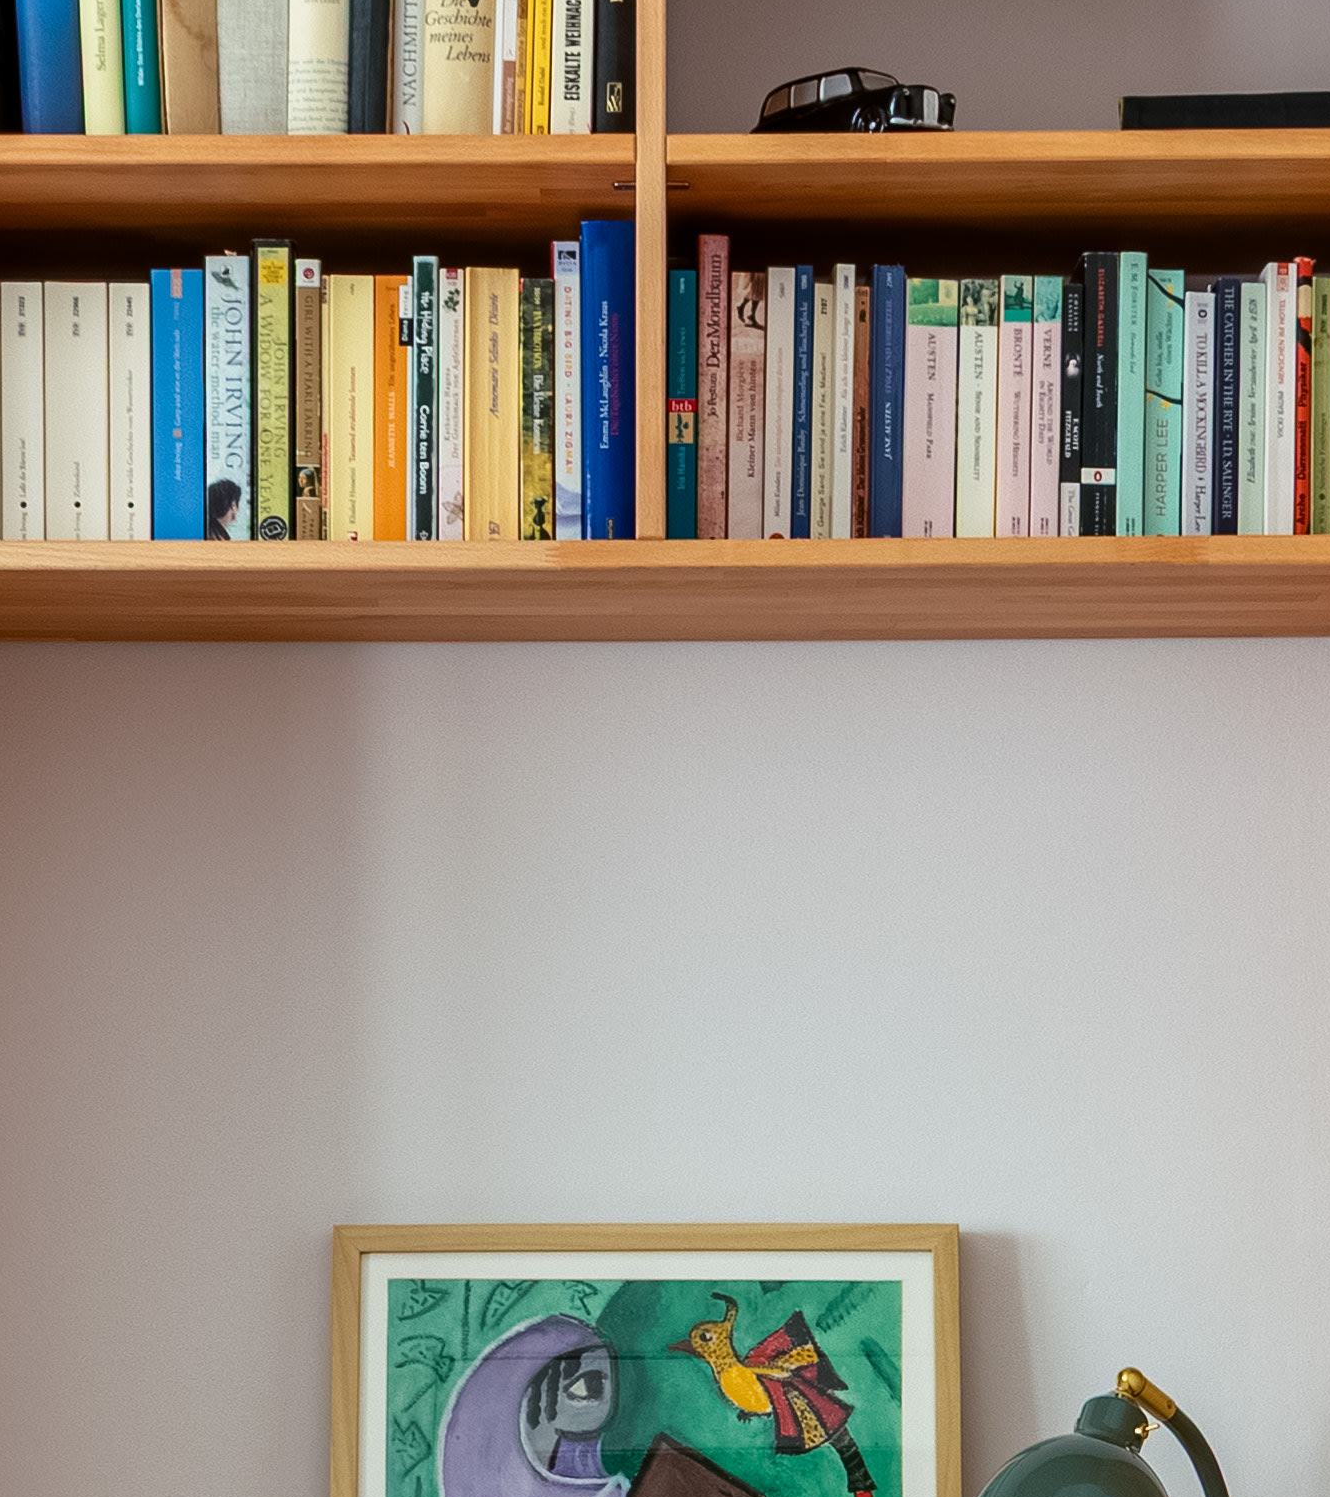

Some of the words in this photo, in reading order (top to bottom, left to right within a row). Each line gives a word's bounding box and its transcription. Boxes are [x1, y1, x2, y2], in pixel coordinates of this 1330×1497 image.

[425, 11, 492, 27] Geschichte
[430, 30, 474, 43] meines
[446, 45, 491, 63] Lebens
[564, 30, 582, 101] EISKALTE
[221, 297, 243, 367] JOHN
[600, 301, 608, 325] Kraus
[273, 338, 286, 389] JOHN
[599, 328, 608, 358] Nicola
[927, 333, 936, 381] AUSTEN
[974, 332, 983, 381] AUSTEN
[1043, 329, 1052, 370] VERNE
[599, 366, 611, 418] McLaughlin
[749, 361, 757, 391] hinten
[225, 376, 243, 469] IRVING
[273, 392, 286, 459] IRVING
[600, 422, 608, 449] Emma
[1157, 419, 1168, 447] LEE
[748, 444, 756, 478] Kleiner
[1156, 452, 1168, 516] HARPER
